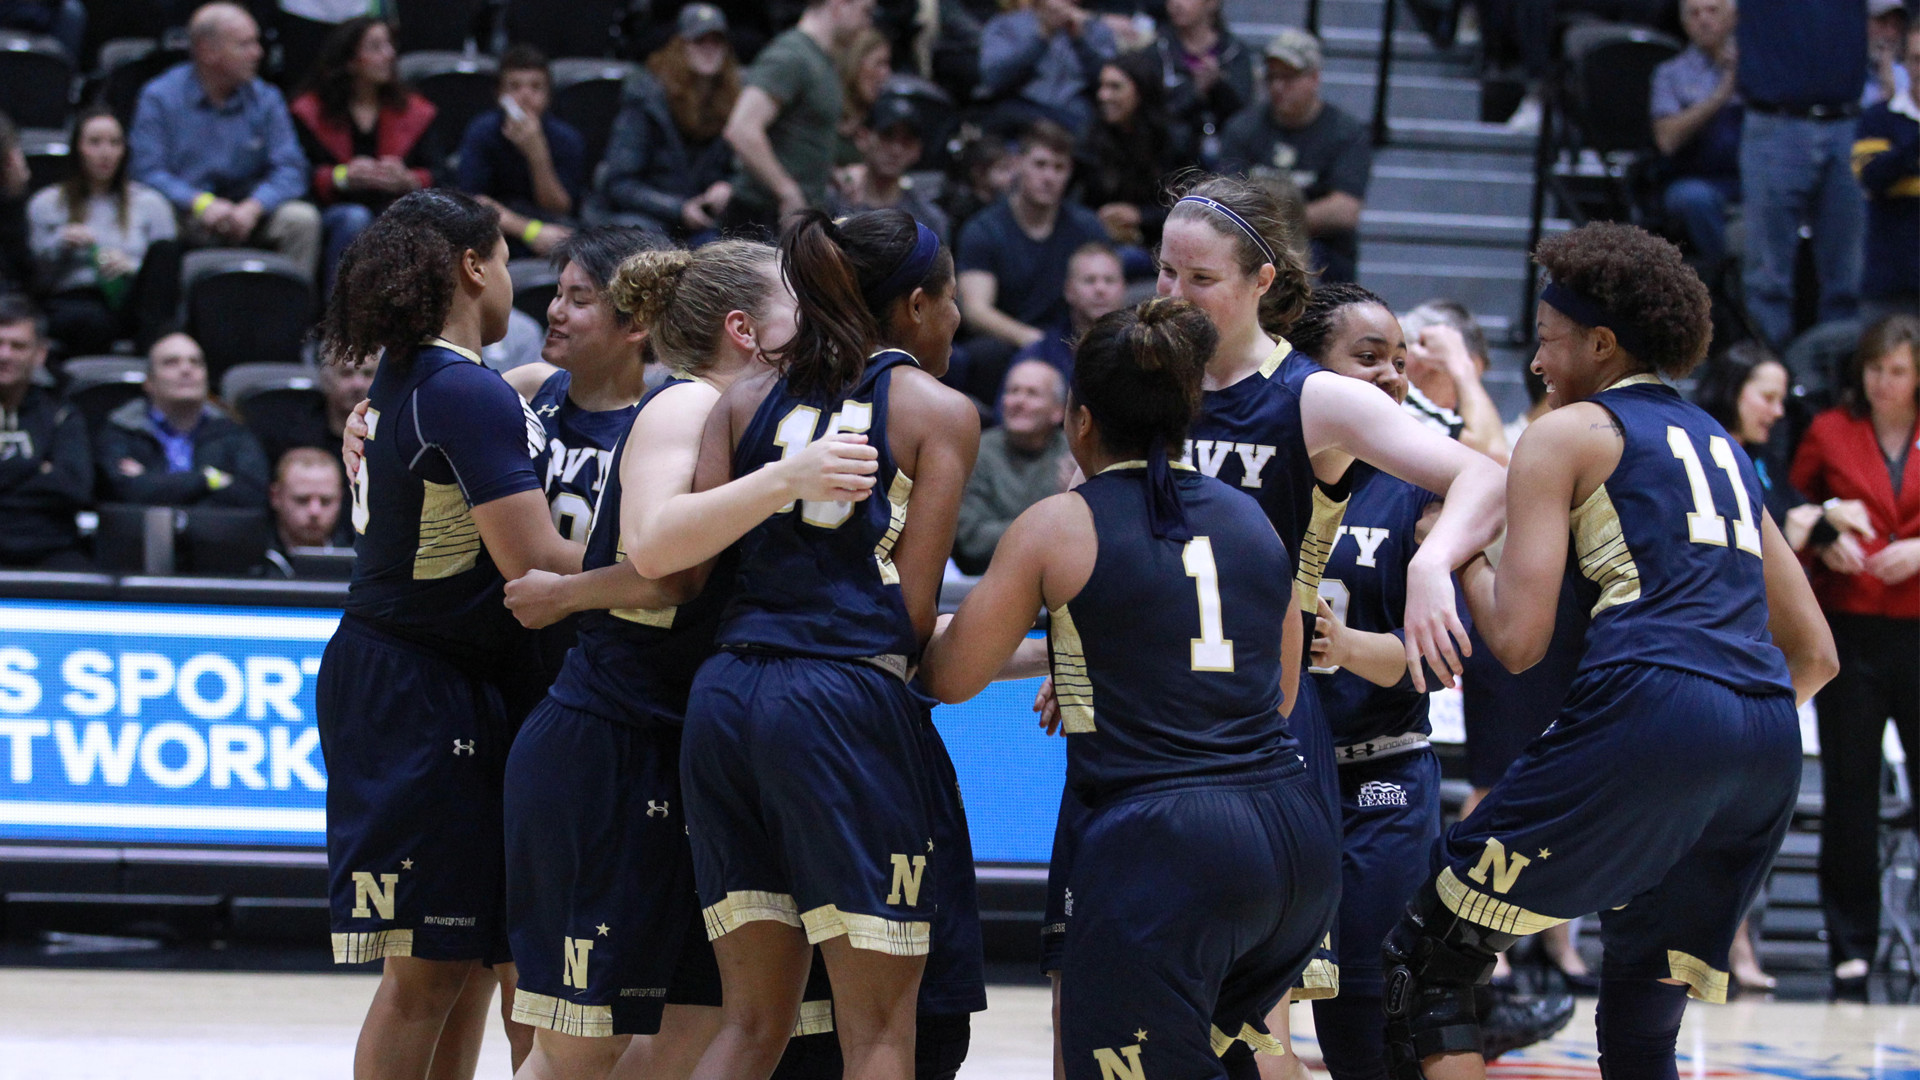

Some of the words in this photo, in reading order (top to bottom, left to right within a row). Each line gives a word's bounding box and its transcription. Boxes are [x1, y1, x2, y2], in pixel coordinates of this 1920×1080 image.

[1667, 425, 1763, 560] 11
[1181, 535, 1235, 673] 1
[0, 648, 43, 714] S
[62, 648, 321, 722] SPOR
[0, 718, 330, 792] TWORK
[1357, 791, 1407, 802] PATRIOT
[1359, 798, 1407, 807] LEAGUE
[886, 853, 927, 907] N
[1467, 836, 1532, 895] N
[351, 871, 399, 920] N
[563, 935, 594, 989] N
[1093, 1043, 1147, 1080] N
